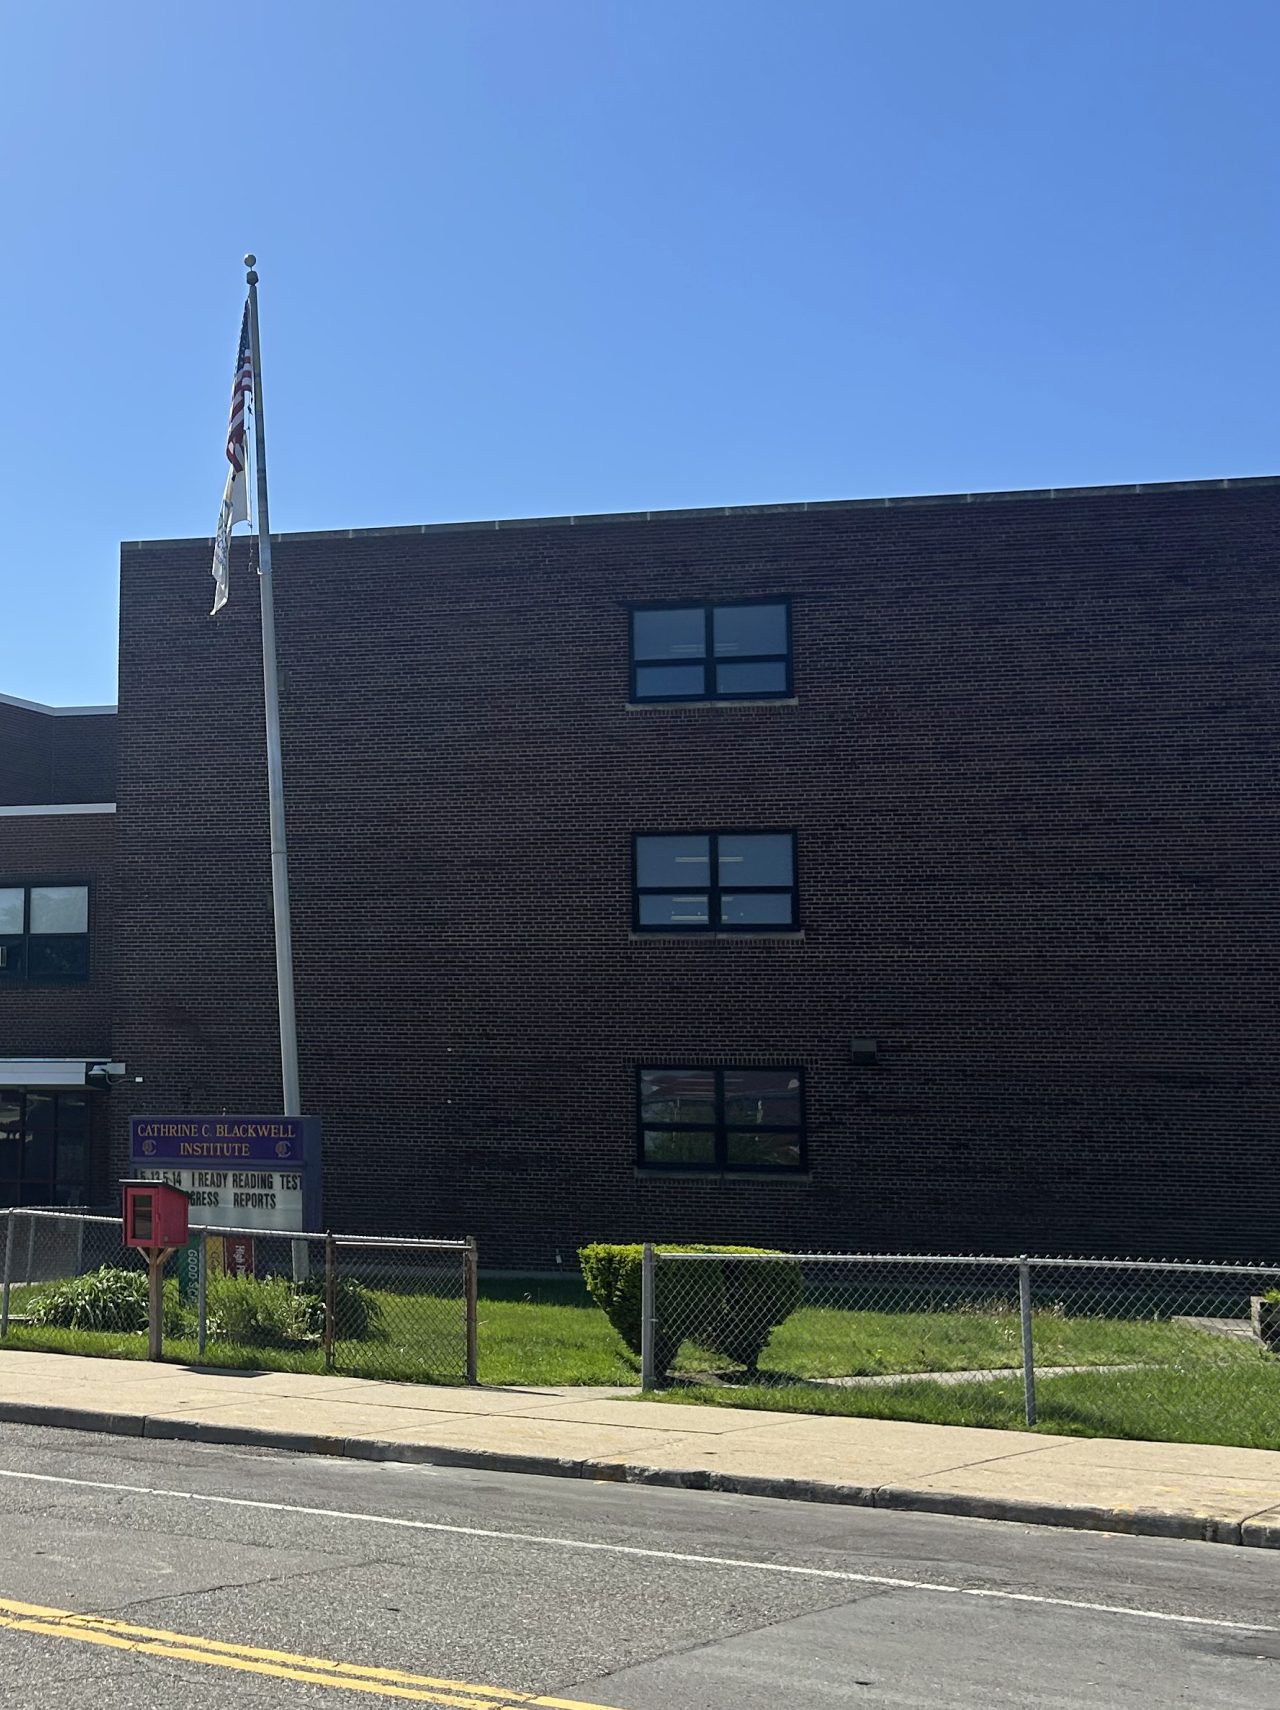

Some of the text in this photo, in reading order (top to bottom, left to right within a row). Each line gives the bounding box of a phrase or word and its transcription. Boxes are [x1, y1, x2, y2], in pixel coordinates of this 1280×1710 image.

[137, 1124, 199, 1137] CATHRINE
[216, 1124, 296, 1138] BLACKWELL
[180, 1142, 250, 1156] INSTITUTE
[198, 1171, 228, 1188] READY
[232, 1172, 274, 1190] READING
[189, 1190, 276, 1210] GRESS REPORTS
[187, 1249, 198, 1279] GOOD
